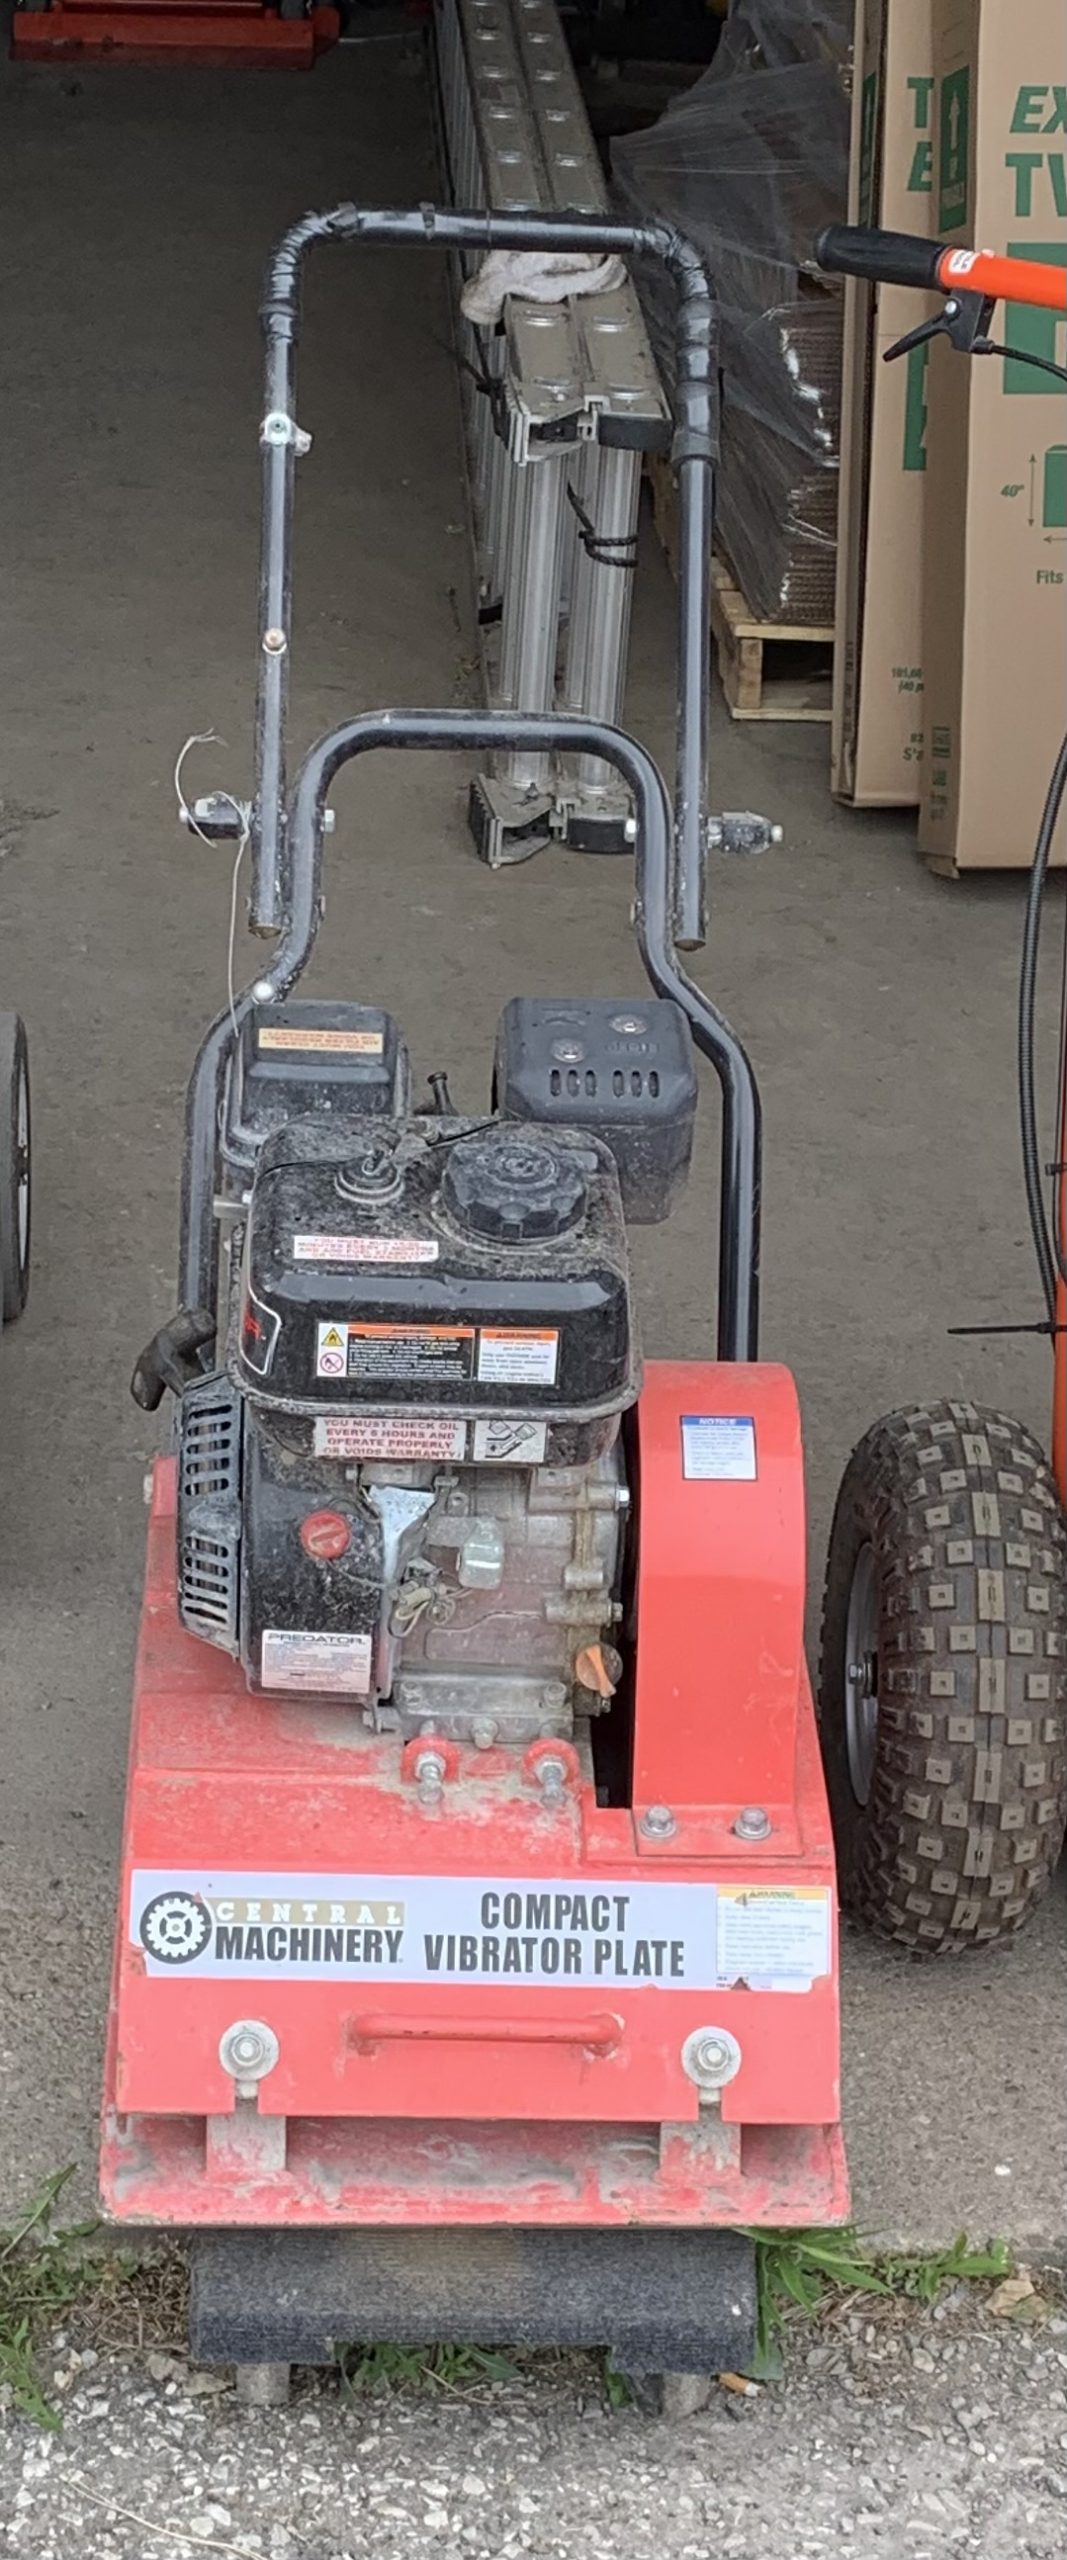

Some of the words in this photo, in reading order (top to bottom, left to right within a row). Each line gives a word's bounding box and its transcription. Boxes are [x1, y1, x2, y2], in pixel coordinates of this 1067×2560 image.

[1036, 570, 1064, 584] Fits
[324, 1419, 349, 1427] YOU
[353, 1420, 387, 1428] MUST
[392, 1421, 435, 1430] CHECK
[440, 1422, 459, 1431] OIL
[326, 1428, 366, 1436] EVERY
[381, 1430, 425, 1438] HOURS
[430, 1431, 456, 1440] AND
[328, 1437, 384, 1447] OPERATE
[388, 1438, 453, 1449] PROPERLY
[345, 1447, 382, 1456] VOIDS
[268, 1633, 364, 1644] PREDATOR
[216, 1902, 401, 1925] CENTRAL
[481, 1892, 630, 1932] COMPACT
[215, 1926, 404, 1964] MACHINERY
[424, 1934, 582, 1975] VIBRATOR
[594, 1939, 685, 1977] PLATE
